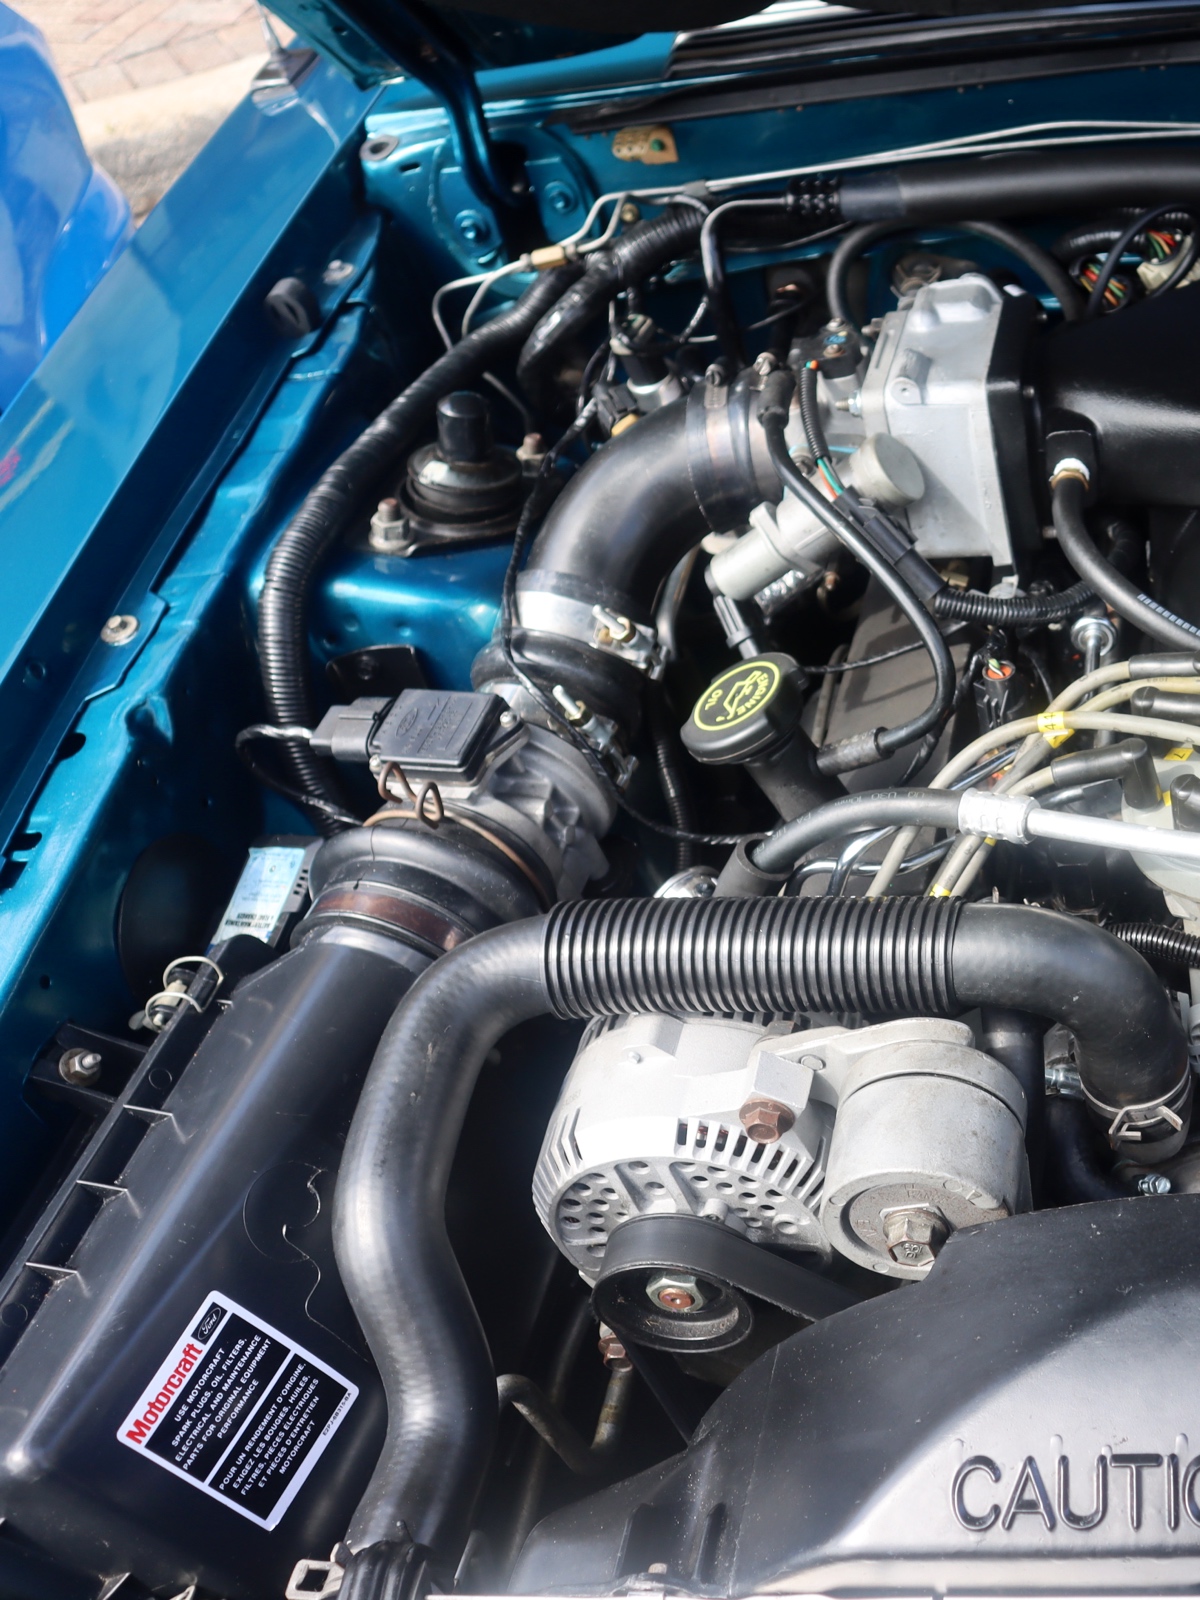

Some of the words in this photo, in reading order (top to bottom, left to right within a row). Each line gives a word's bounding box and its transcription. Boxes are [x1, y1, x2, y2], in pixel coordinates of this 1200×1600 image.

[705, 689, 723, 710] OIL
[736, 672, 769, 716] ENGINE
[126, 1344, 202, 1444] Motorcraft
[201, 1313, 218, 1335] Ford
[175, 1404, 189, 1421] USE
[187, 1348, 224, 1403] MOTORCRAFT
[175, 1413, 211, 1461] ELECTRICAL
[210, 1393, 223, 1410] AND
[222, 1335, 261, 1391] MAINTENANCE
[183, 1443, 203, 1470] PARTS
[202, 1424, 216, 1441] FOR
[215, 1387, 242, 1422] ORIGINAL
[240, 1339, 270, 1383] EQUIPMENT
[172, 1419, 192, 1446] SPARK
[217, 1379, 258, 1438] PERFORMANCE
[219, 1467, 237, 1490] POUR
[236, 1453, 246, 1464] UN
[245, 1404, 277, 1451] RENDEMENT
[233, 1459, 254, 1488] EXIGEZ
[253, 1442, 265, 1457] LES
[279, 1420, 314, 1474] MOTORCRAFT
[258, 1476, 267, 1487] ET
